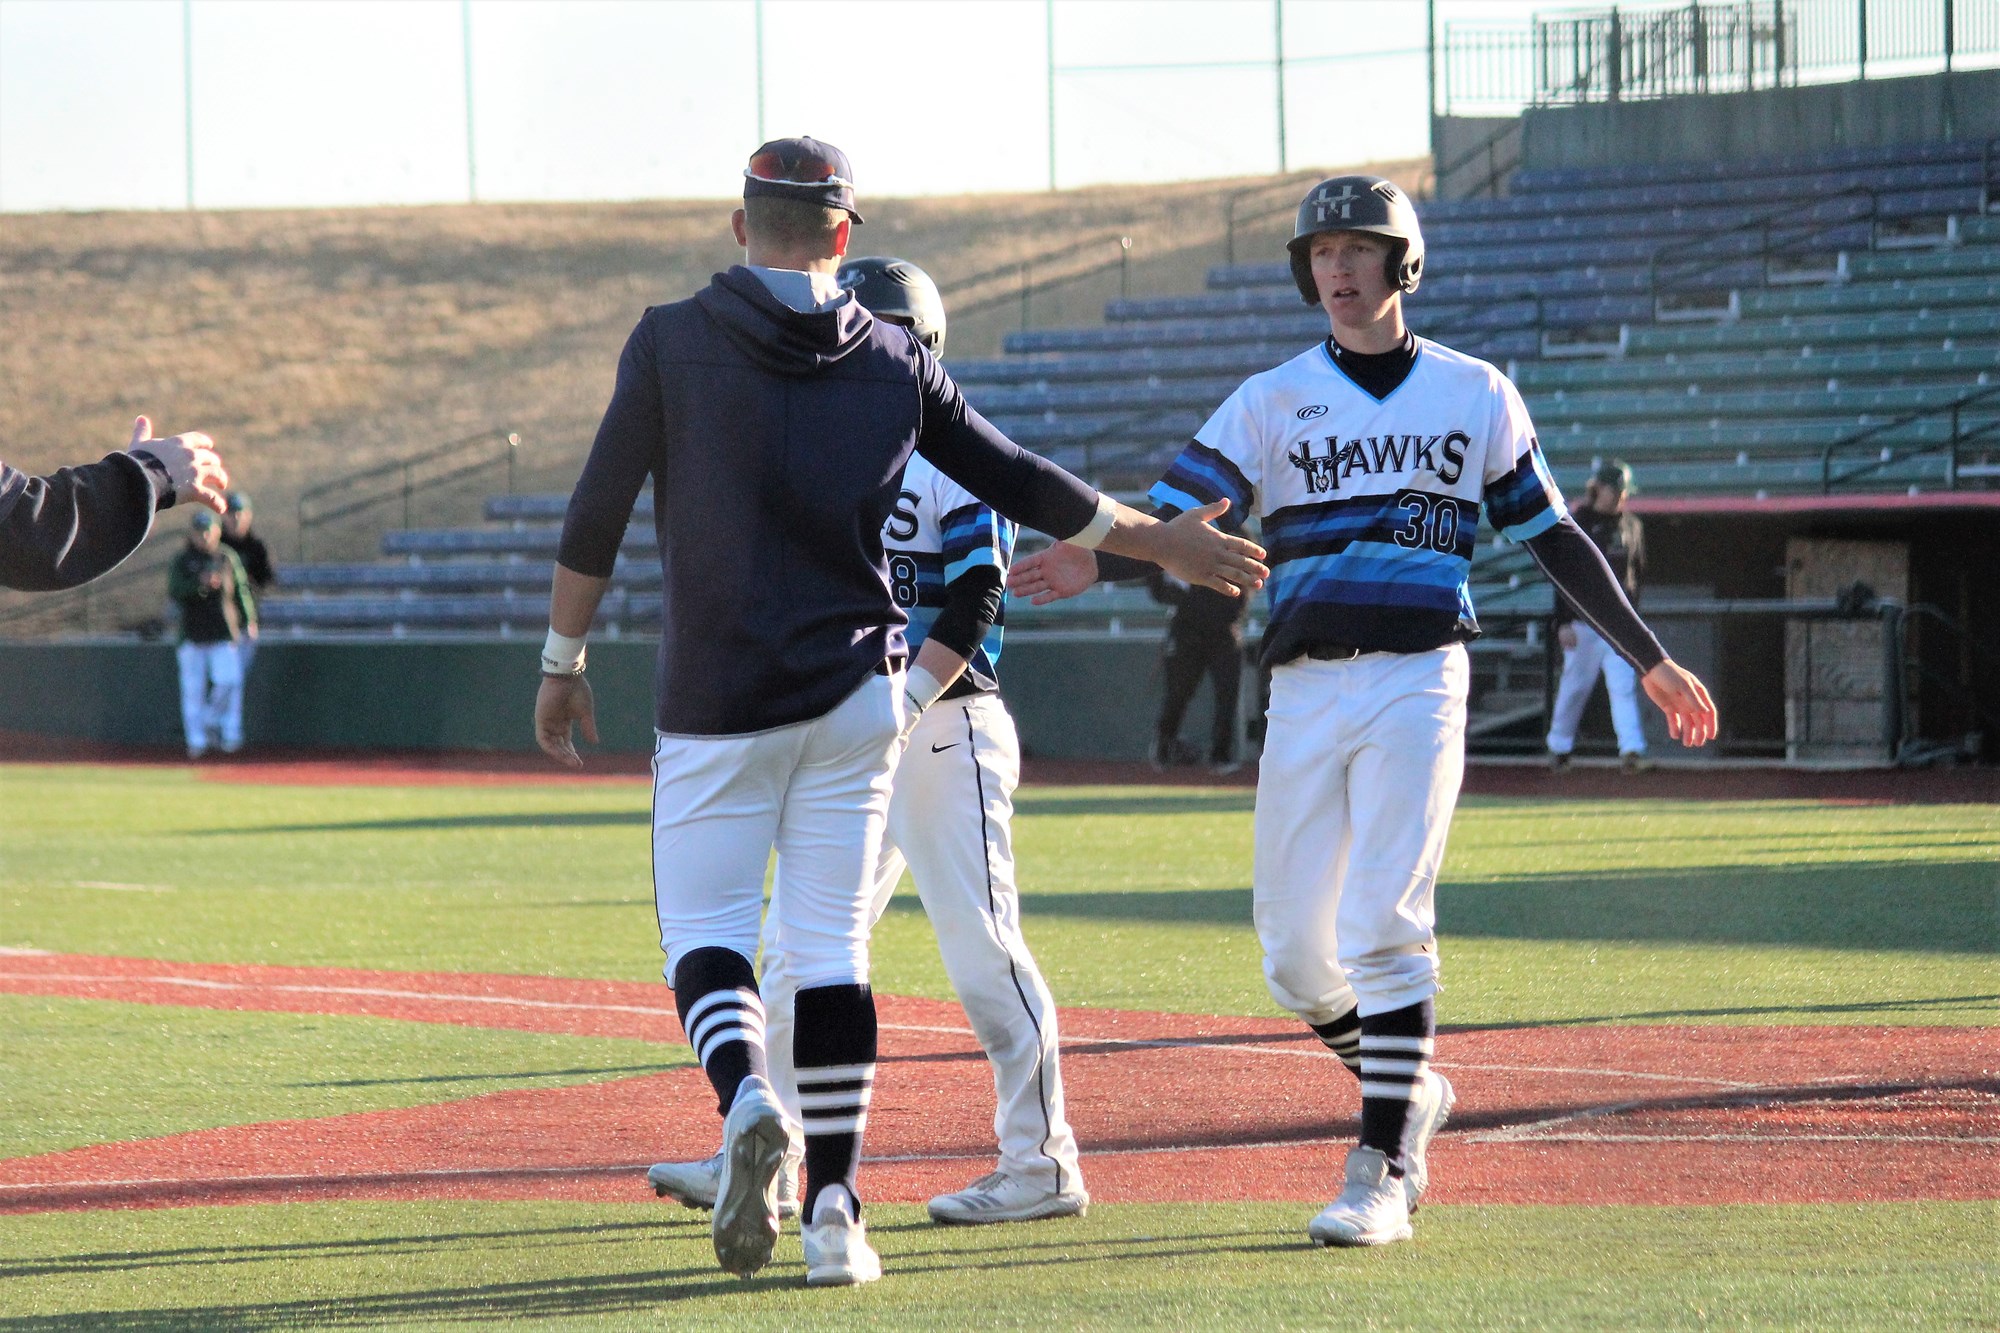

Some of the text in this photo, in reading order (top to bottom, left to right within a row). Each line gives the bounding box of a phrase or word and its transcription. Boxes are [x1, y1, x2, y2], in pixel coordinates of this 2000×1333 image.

[1298, 429, 1472, 494] HAWKS
[881, 488, 922, 542] S
[1393, 492, 1460, 555] 30
[889, 554, 919, 609] 8
